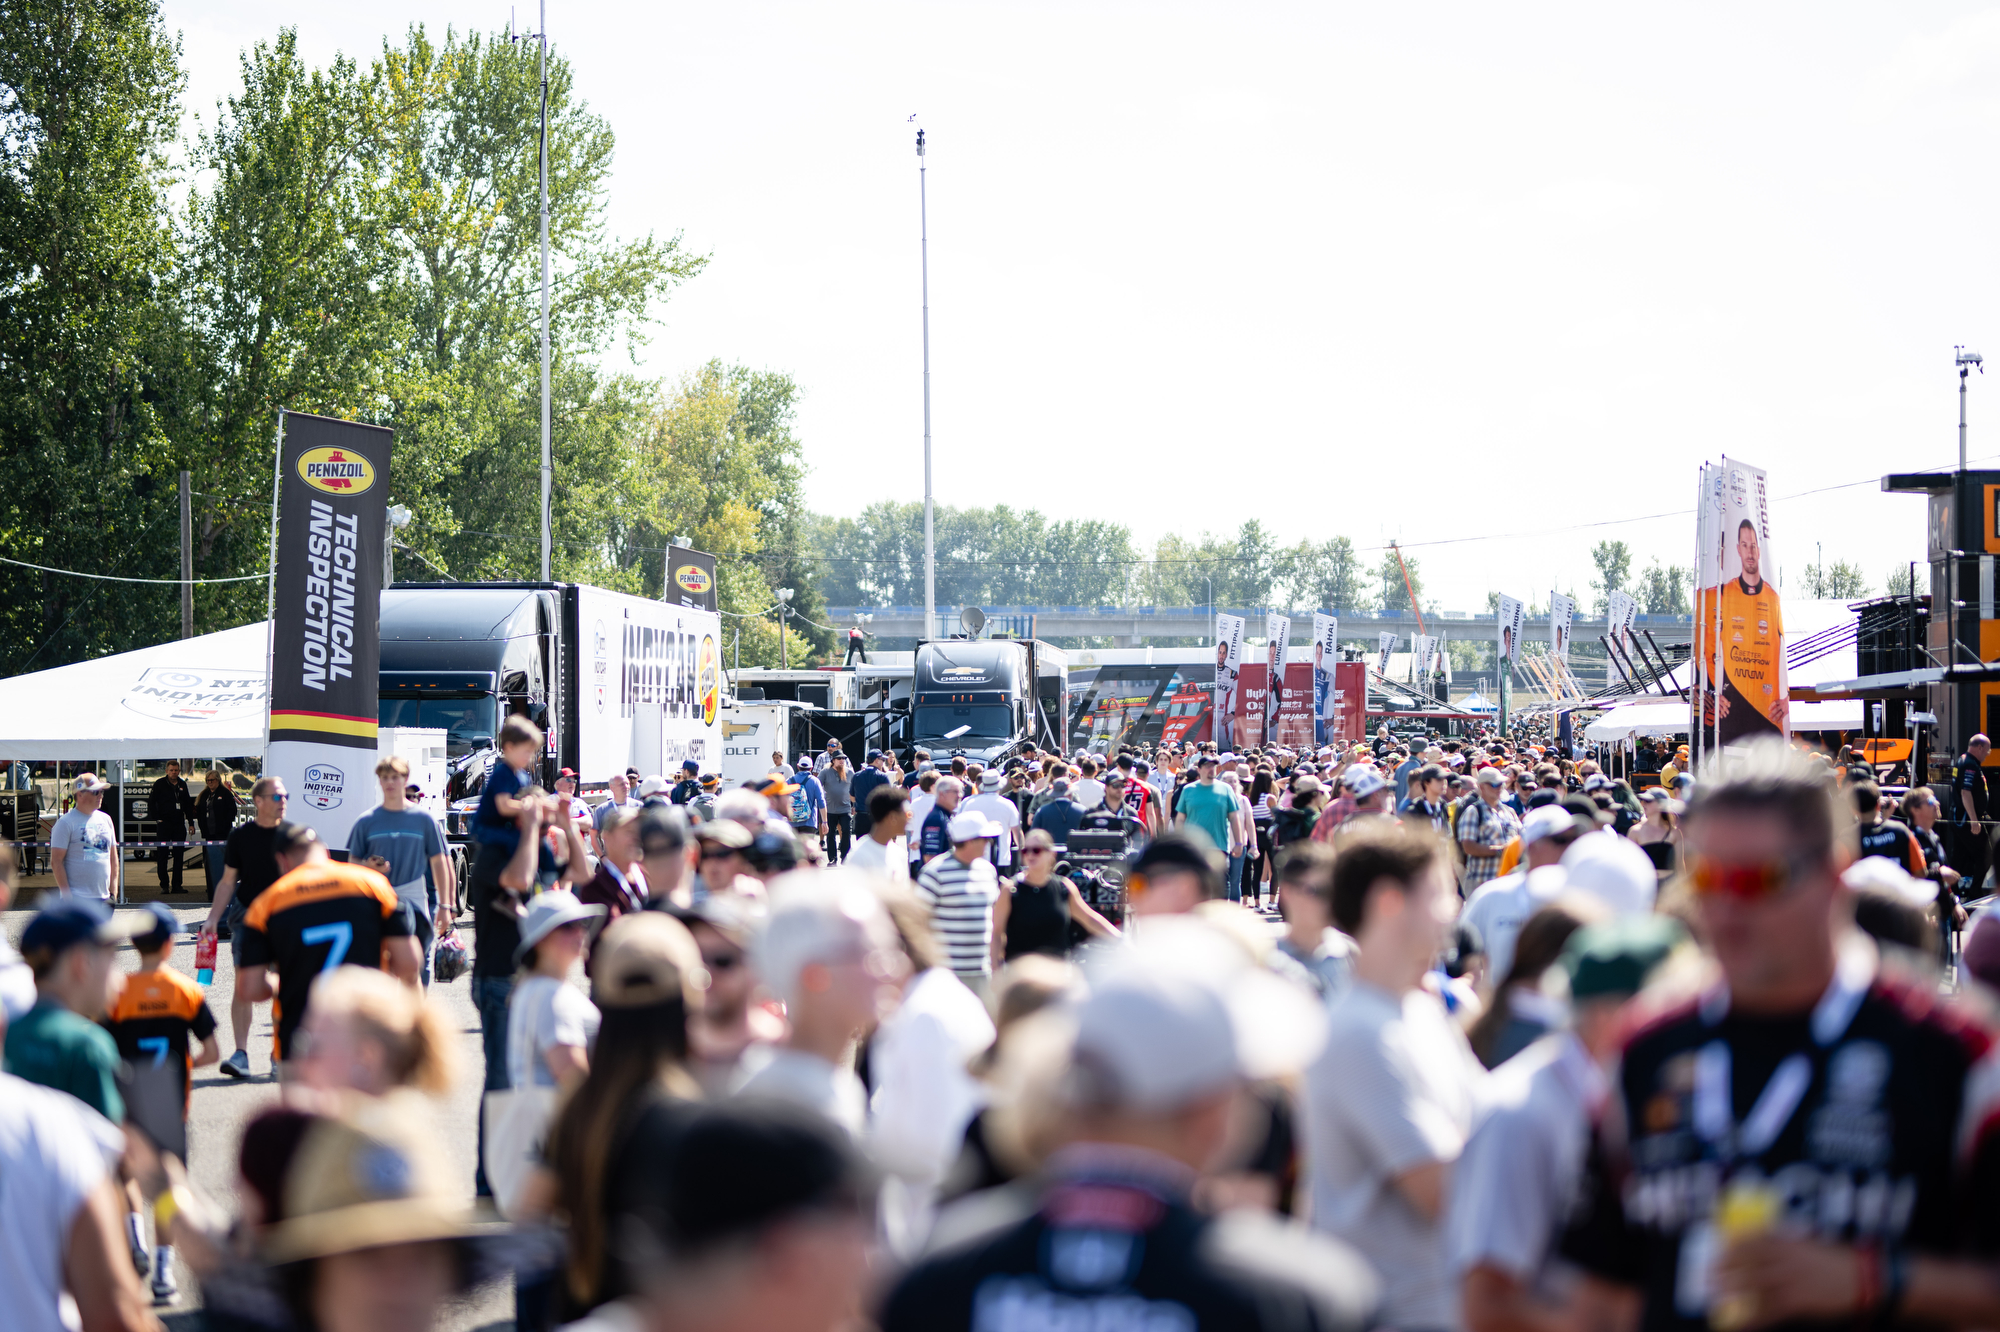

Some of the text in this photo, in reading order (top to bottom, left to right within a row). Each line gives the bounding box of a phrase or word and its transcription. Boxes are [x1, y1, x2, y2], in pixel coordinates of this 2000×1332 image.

[307, 463, 364, 478] PENNZOIL
[1757, 475, 1770, 539] ROSSI
[680, 574, 707, 584] PENNZOIL
[302, 500, 333, 691] INSPECTION
[329, 514, 358, 682] TECHNICAL
[1229, 620, 1241, 660] FITTIPALDI
[1325, 621, 1335, 655] RAHAL
[1426, 638, 1436, 662] VEEKAY
[1733, 656, 1771, 665] TOMORROW
[1280, 713, 1310, 721] MI-JACK
[724, 747, 759, 755] OLET
[323, 772, 341, 782] NTT
[1875, 763, 1897, 784] 7
[304, 783, 343, 793] INDYCAR
[301, 921, 354, 986] 7
[137, 1036, 170, 1073] 7
